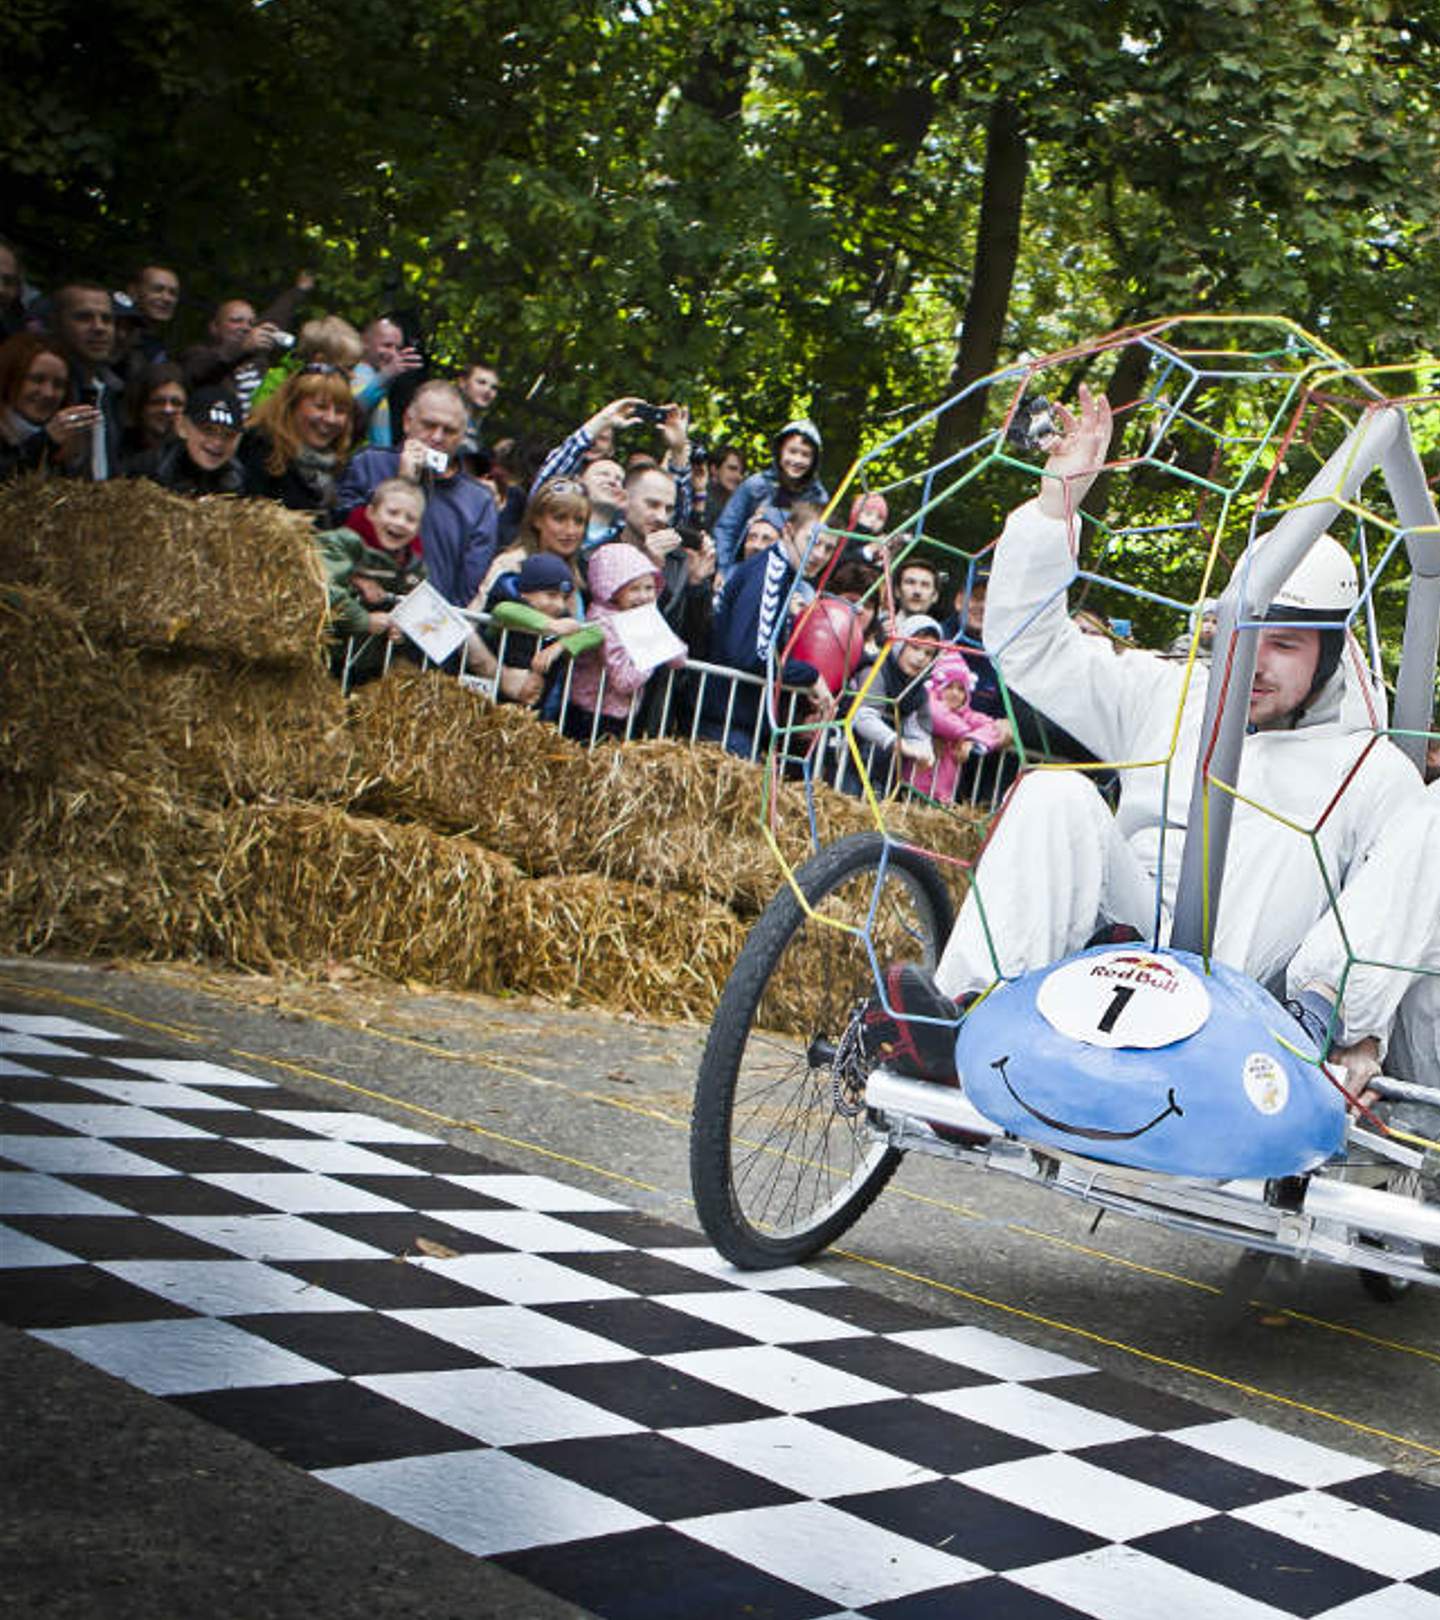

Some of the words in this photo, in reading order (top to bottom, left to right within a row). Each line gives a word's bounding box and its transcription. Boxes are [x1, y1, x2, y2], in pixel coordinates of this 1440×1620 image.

[1090, 965, 1135, 979] Red
[1135, 970, 1179, 993] Bull
[1097, 984, 1136, 1034] 1
